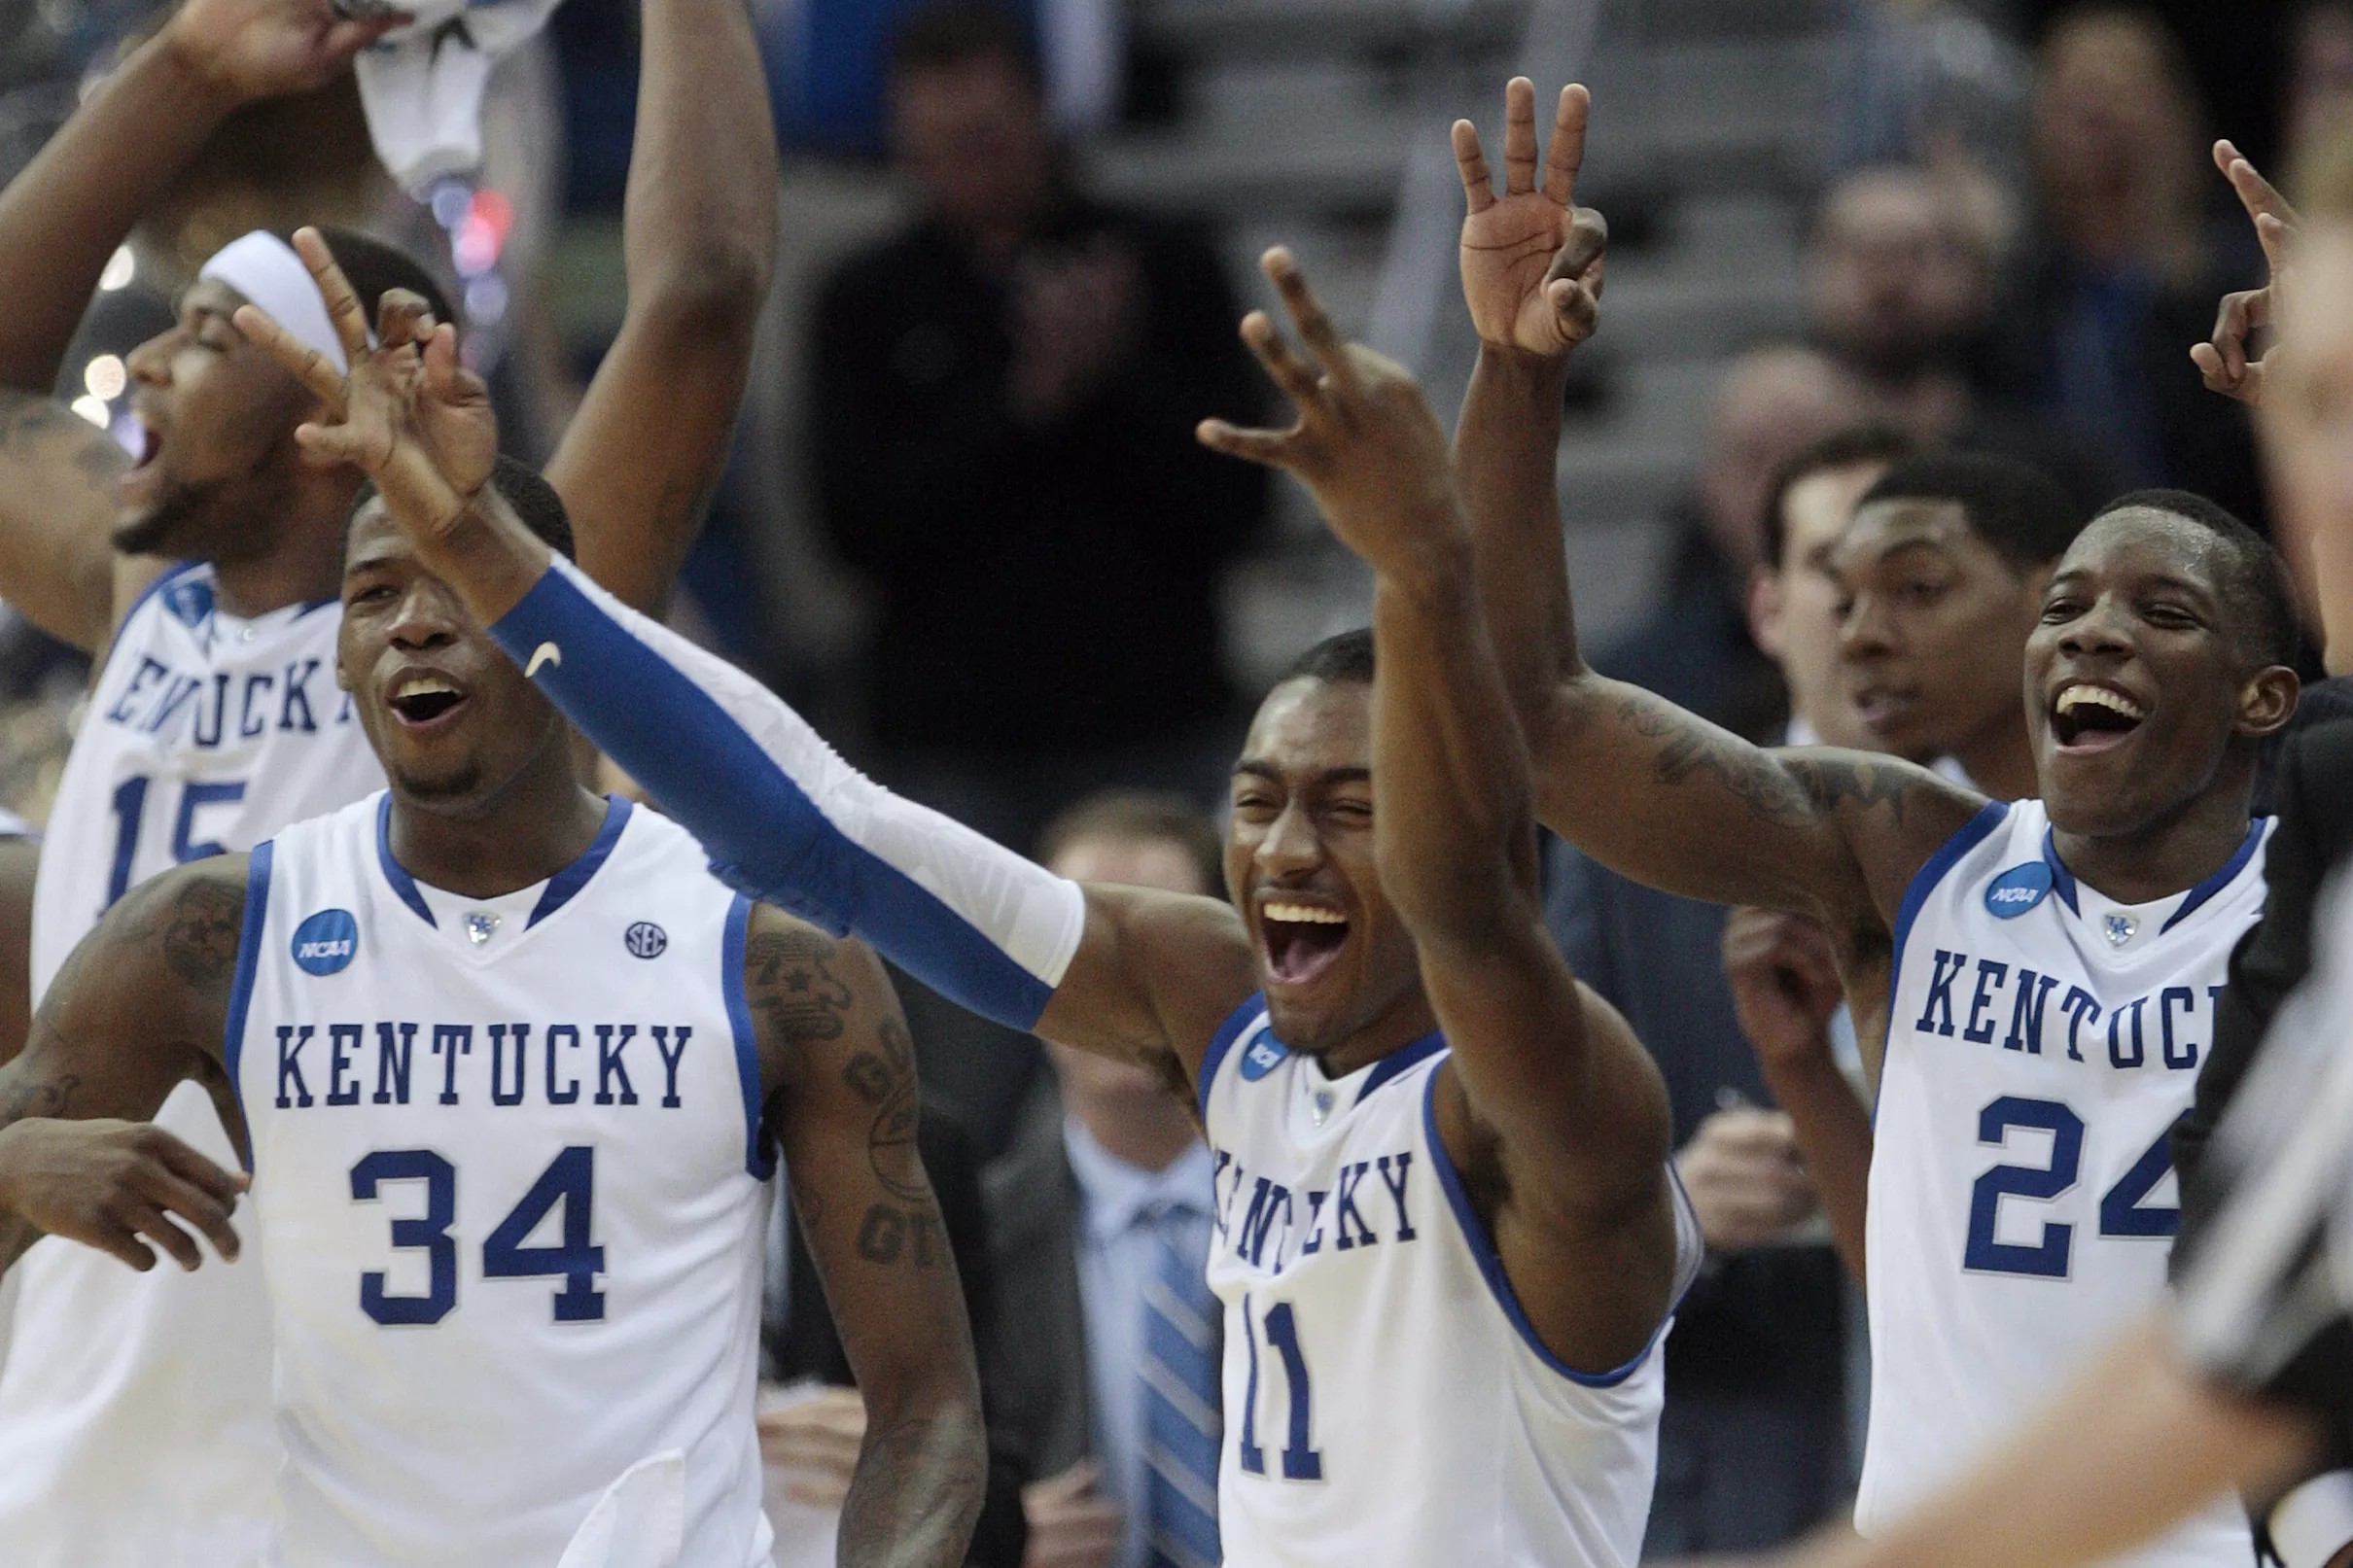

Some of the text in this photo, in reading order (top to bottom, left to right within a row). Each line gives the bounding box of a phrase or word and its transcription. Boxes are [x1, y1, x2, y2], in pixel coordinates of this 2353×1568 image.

[1991, 887, 2038, 904] NCAA
[299, 938, 352, 958] NCAA
[626, 924, 666, 956] SEC
[1915, 949, 2228, 1069] KENTUC
[275, 1023, 692, 1108] KENTUCKY
[350, 1146, 606, 1325] 34
[1240, 1291, 1323, 1481] 11
